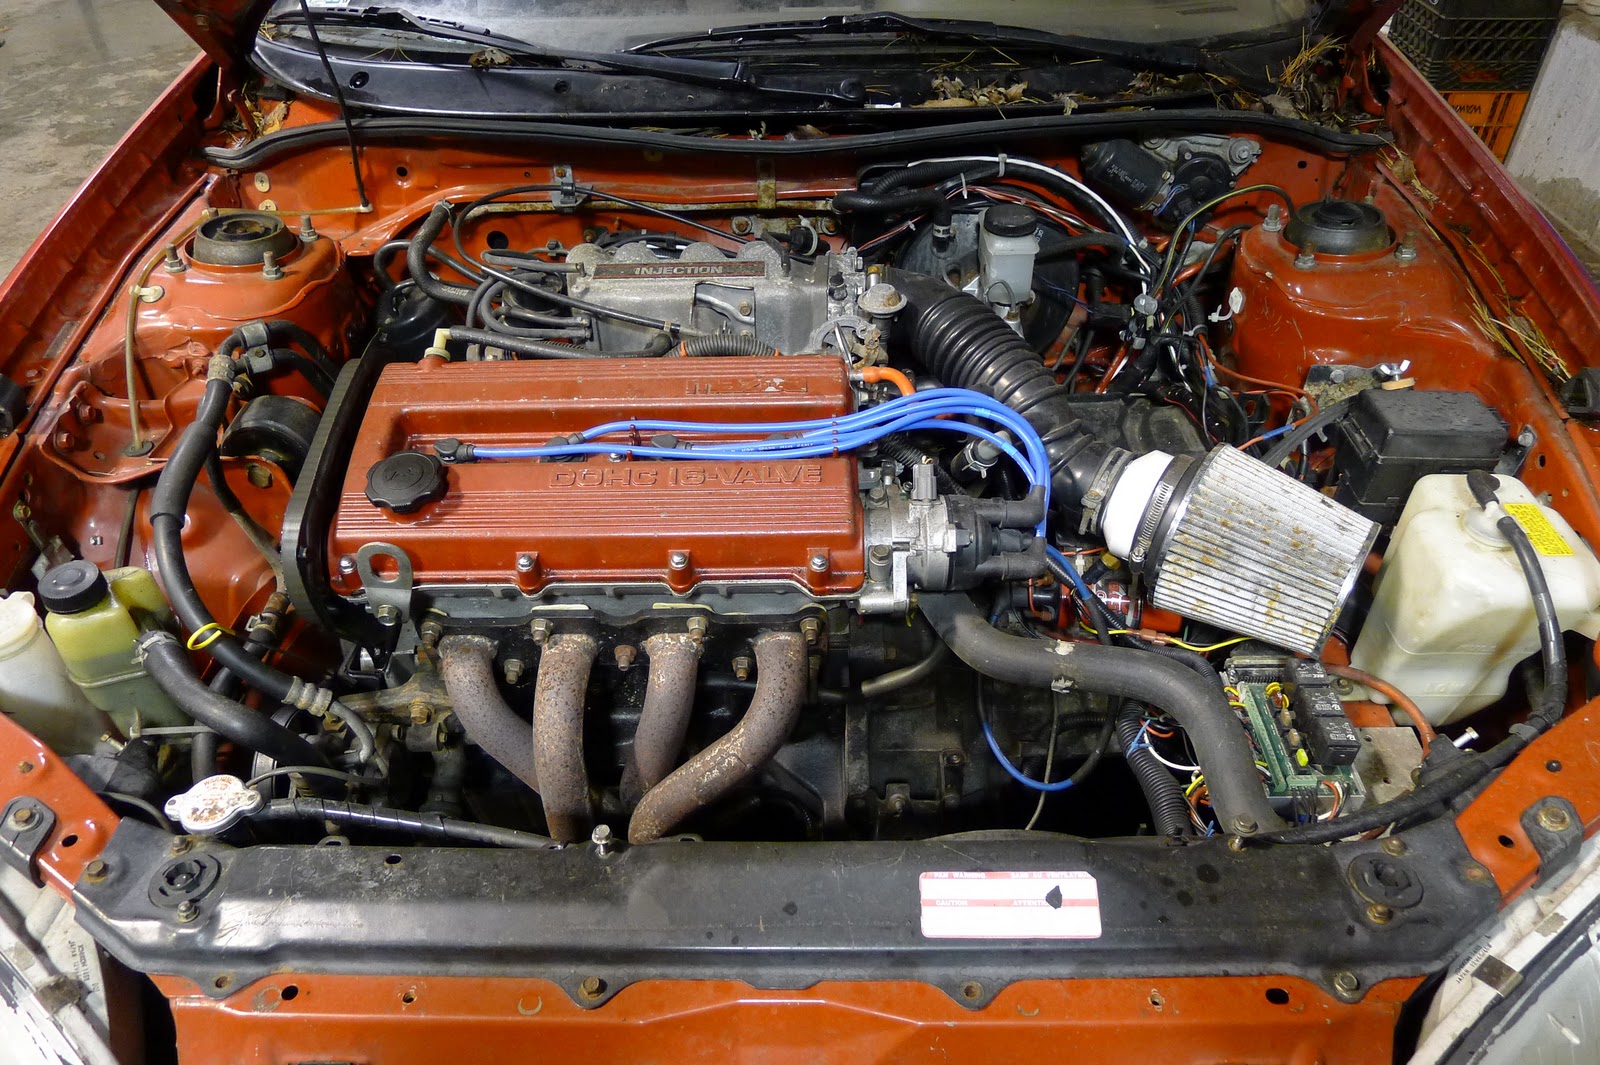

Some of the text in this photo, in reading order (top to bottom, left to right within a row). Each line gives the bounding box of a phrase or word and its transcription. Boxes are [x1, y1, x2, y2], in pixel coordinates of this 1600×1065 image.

[635, 266, 723, 275] INJECTION
[549, 464, 823, 488] DOHC 16-VALVE
